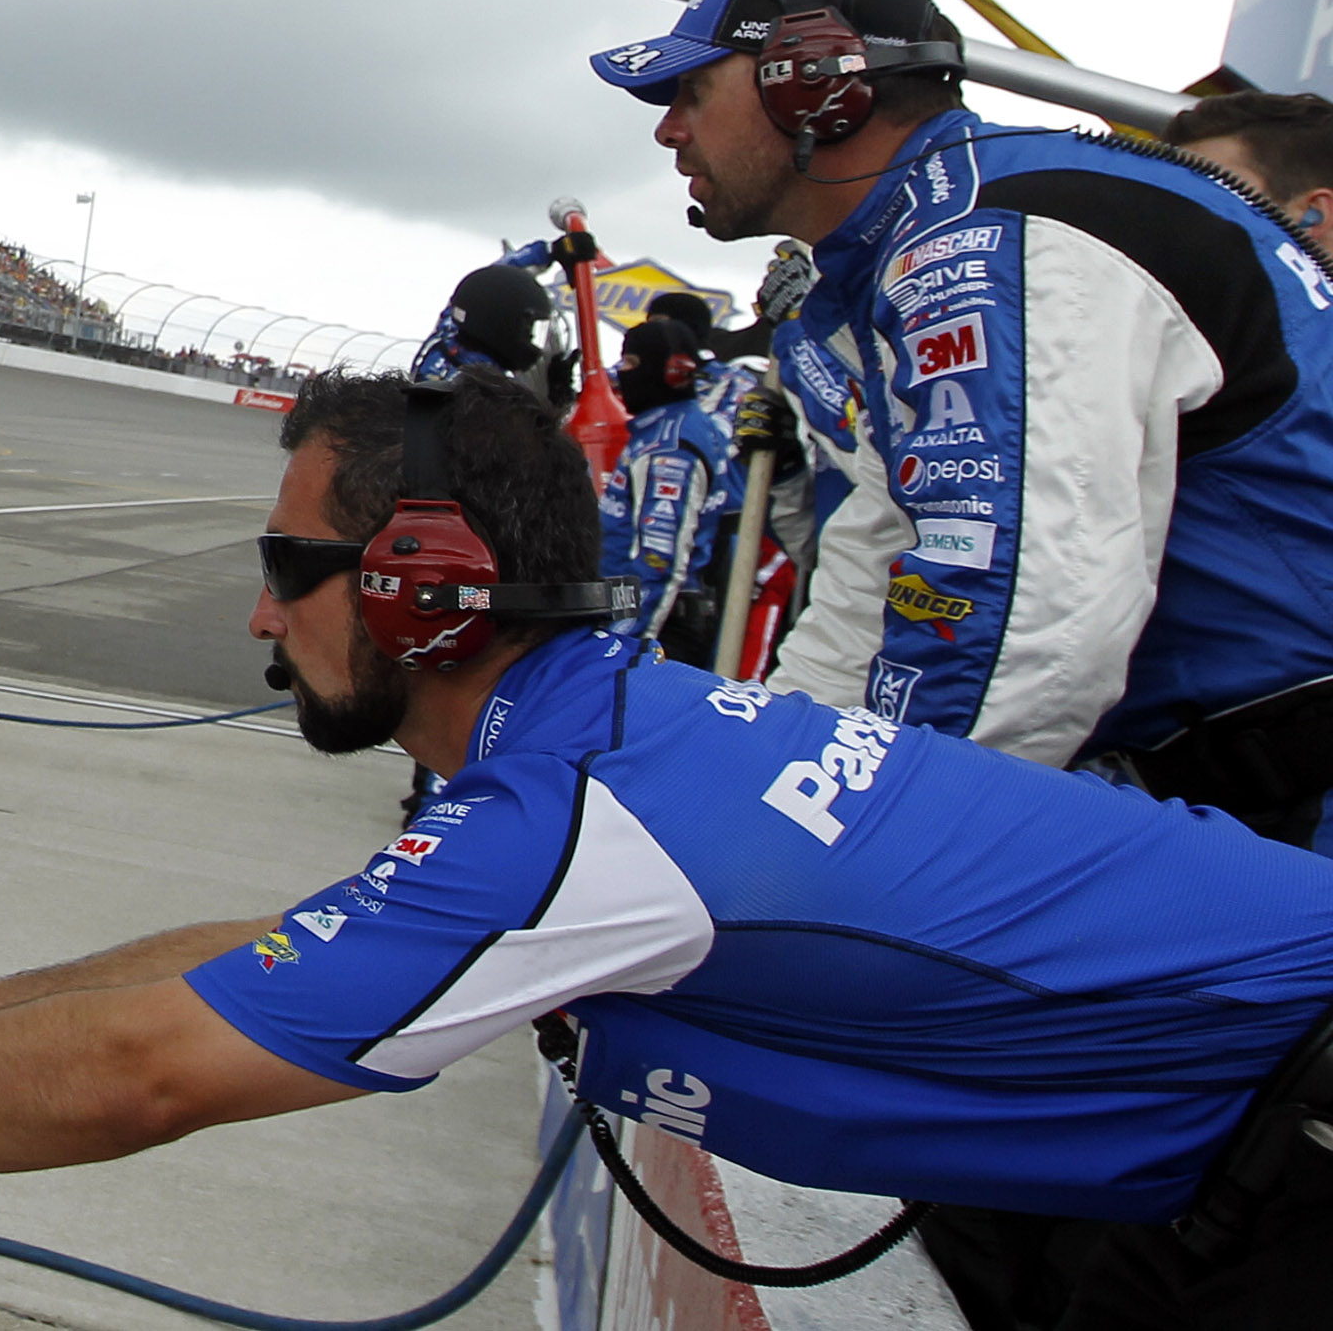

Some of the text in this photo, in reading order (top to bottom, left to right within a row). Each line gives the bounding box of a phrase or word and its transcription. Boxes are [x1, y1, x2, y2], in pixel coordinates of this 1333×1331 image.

[732, 29, 769, 40] ARM
[741, 20, 771, 32] UND
[609, 44, 662, 73] 24
[912, 230, 992, 269] NASCAR
[886, 259, 988, 313] DRIVE
[930, 281, 995, 303] HUNGER
[917, 324, 978, 376] 3M
[909, 427, 986, 449] AXALTA
[926, 454, 1001, 487] pepsi
[889, 582, 969, 617] UNOCO
